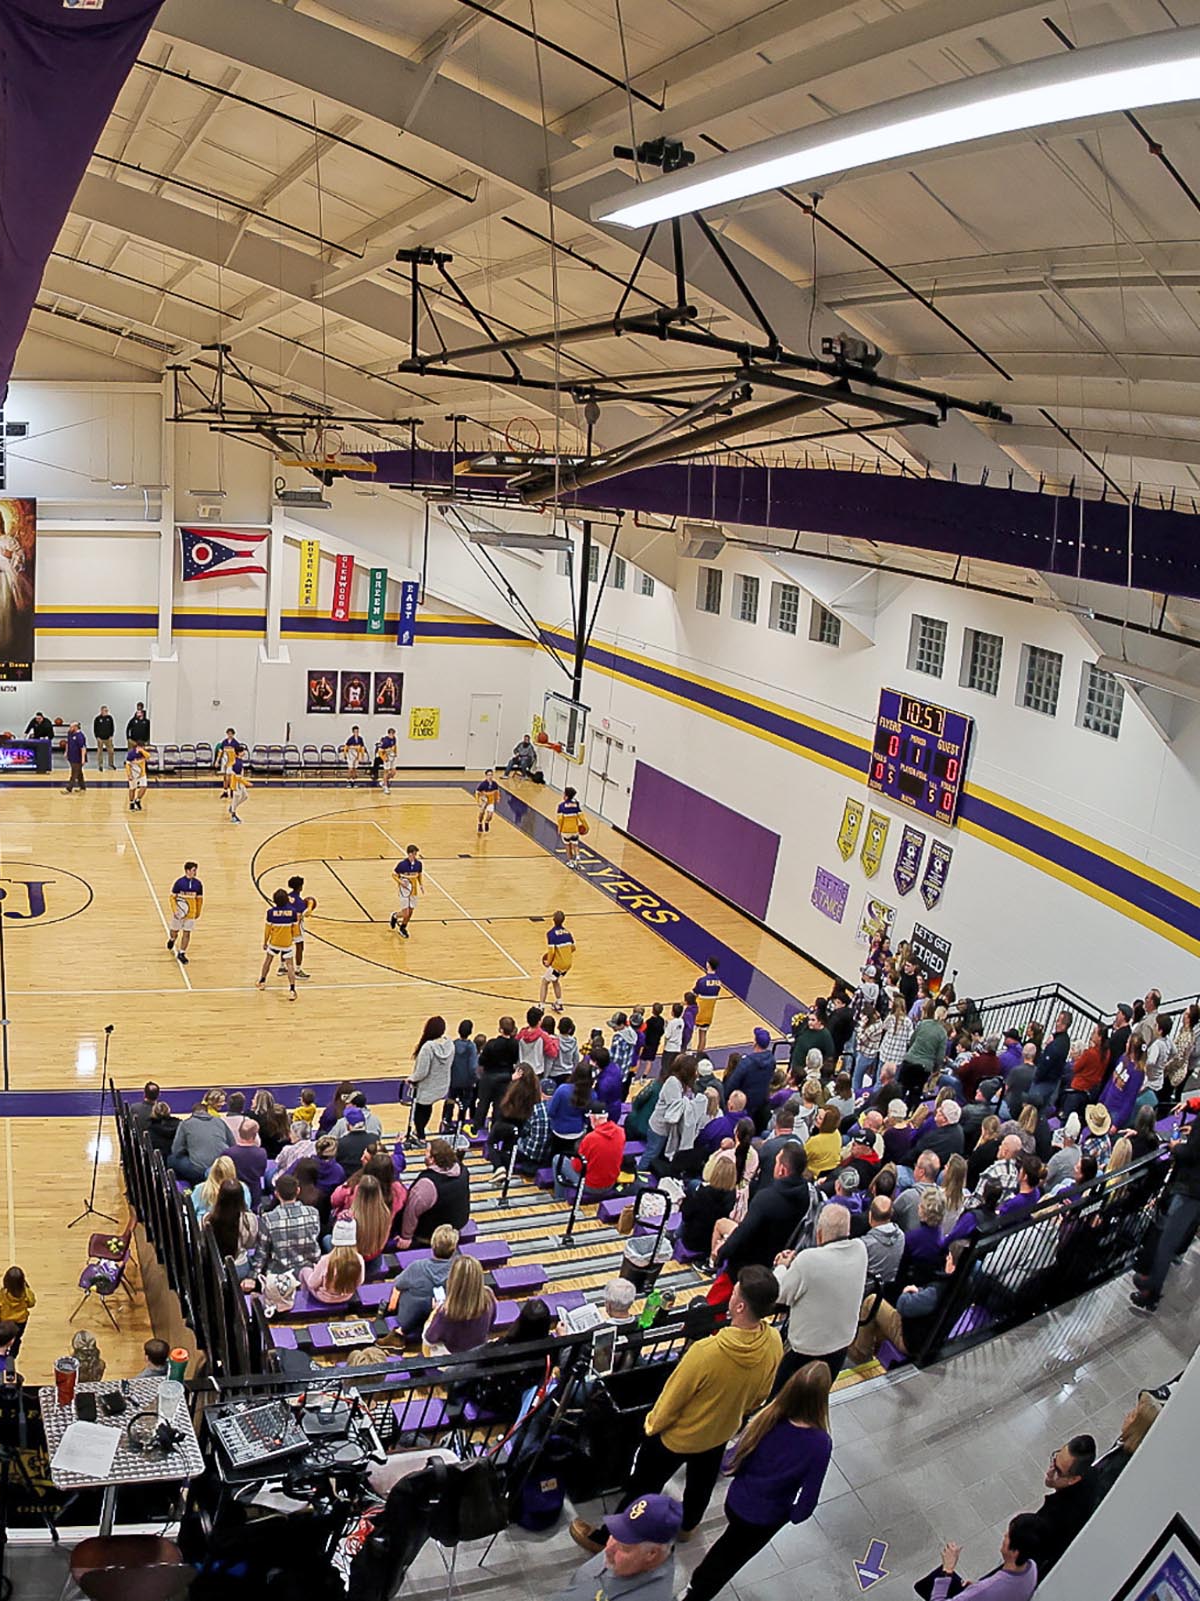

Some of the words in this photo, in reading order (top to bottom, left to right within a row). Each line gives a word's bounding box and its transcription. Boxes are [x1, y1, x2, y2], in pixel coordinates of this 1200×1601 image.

[338, 556, 348, 607] GLENWOOD
[373, 571, 382, 615] GREEN
[405, 584, 414, 619] EAST
[879, 715, 902, 734] FLYERS
[937, 739, 960, 757] GUEST
[907, 701, 942, 732] 10:57
[888, 735, 899, 757] 0
[915, 748, 921, 764] 1
[946, 758, 958, 782] 0
[875, 763, 884, 779] 0
[943, 792, 952, 810] 0
[555, 848, 680, 924] FLYERS
[912, 941, 945, 974] FIRED
[915, 923, 935, 943] LET'S
[933, 937, 951, 954] GET
